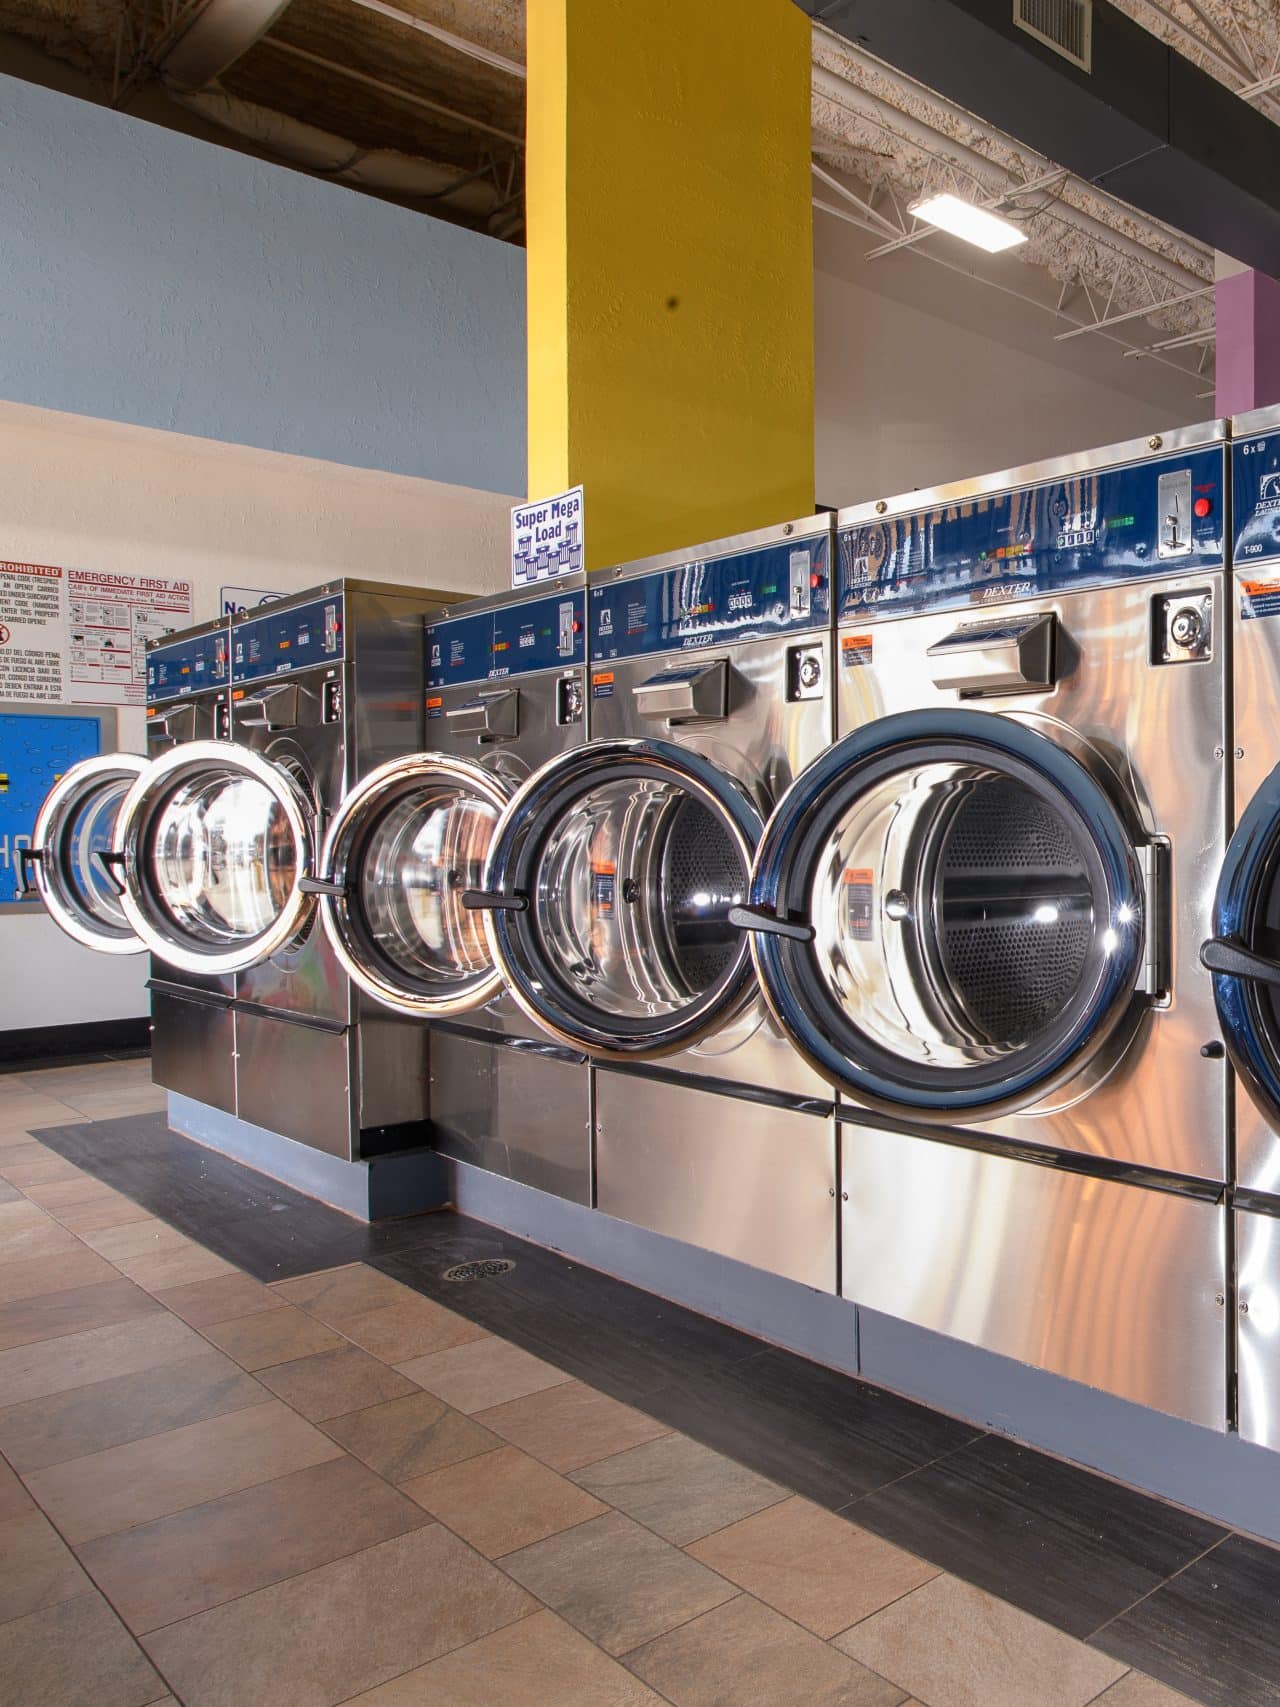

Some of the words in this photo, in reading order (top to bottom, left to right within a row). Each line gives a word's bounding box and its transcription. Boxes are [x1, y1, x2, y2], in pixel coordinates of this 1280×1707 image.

[1243, 444, 1249, 455] 6
[516, 509, 548, 529] Super
[552, 499, 580, 519] Mega
[536, 520, 562, 542] Load
[0, 563, 59, 576] ROHIBITED
[68, 570, 136, 585] EMERGENCY
[140, 578, 169, 589] FIRST
[173, 582, 190, 592] AID
[983, 581, 1030, 598] DEXTER
